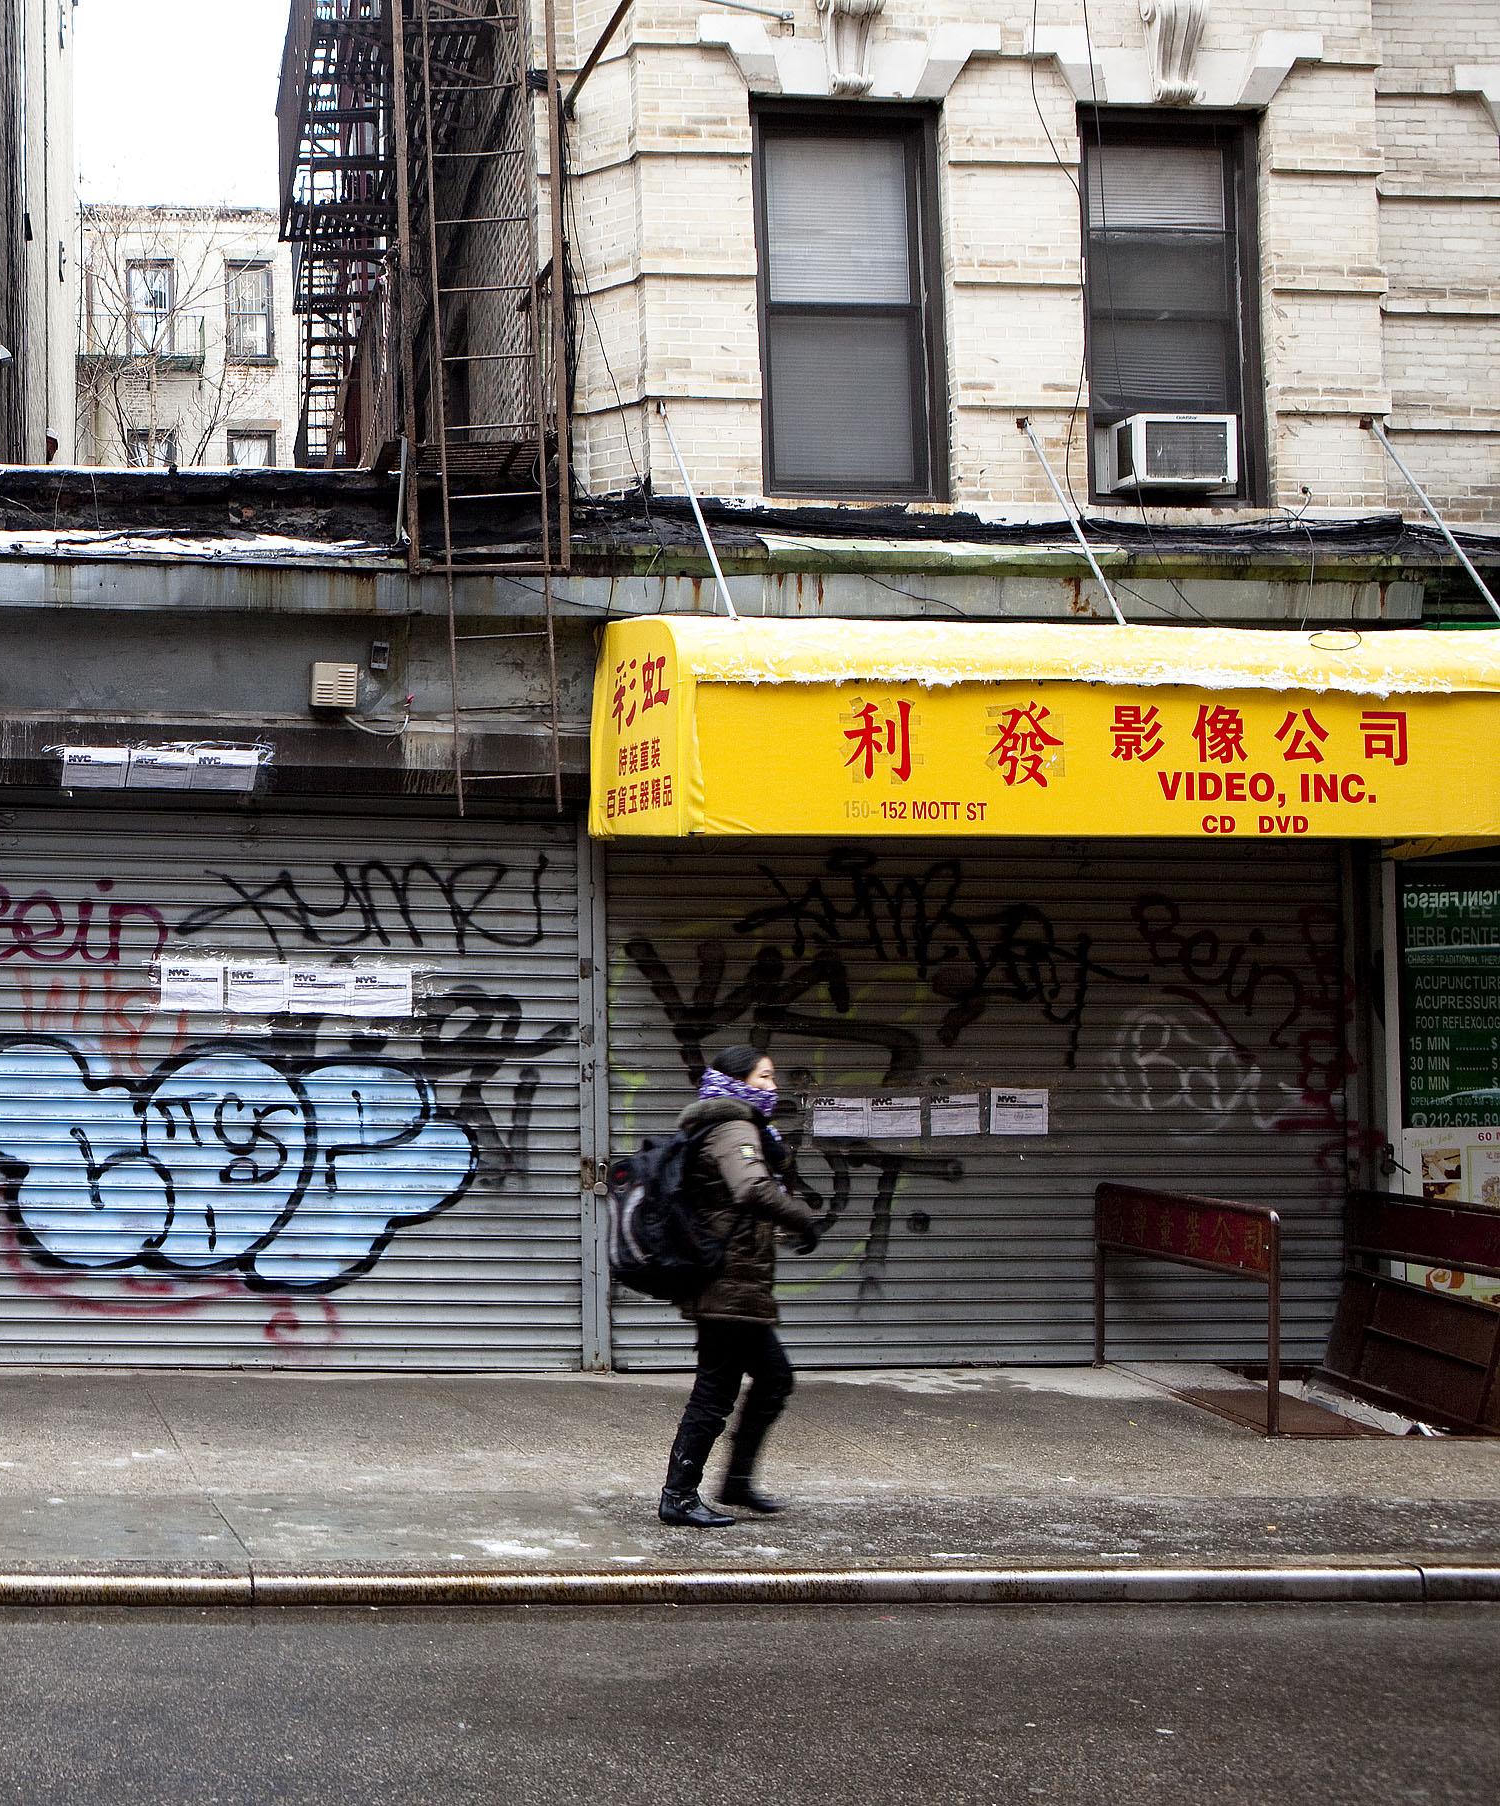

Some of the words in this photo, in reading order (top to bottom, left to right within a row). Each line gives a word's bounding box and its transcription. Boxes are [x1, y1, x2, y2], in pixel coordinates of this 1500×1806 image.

[611, 651, 671, 735] 彩虹
[843, 699, 1409, 788] 利發影像公司
[68, 755, 92, 763] NYC
[199, 757, 221, 765] NYC
[606, 775, 673, 819] 百貨玉器精品
[1157, 771, 1287, 809] VIDEO,
[1300, 773, 1377, 804] INC.
[912, 800, 961, 820] MOTT
[966, 802, 988, 821] ST
[1201, 815, 1236, 834] CD
[1258, 815, 1310, 834] DVD
[1406, 926, 1447, 946] HERB
[168, 969, 190, 977] NYC
[295, 974, 317, 982] NYC
[356, 976, 378, 984] NYC
[1415, 1015, 1440, 1029] FOOT
[1410, 1036, 1423, 1051] 15
[1427, 1036, 1450, 1051] MIN
[1410, 1056, 1423, 1071] 30
[1427, 1056, 1450, 1071] MIN
[1410, 1076, 1423, 1091] 60
[1427, 1076, 1450, 1091] MIN
[872, 1098, 893, 1106] NYC
[930, 1096, 950, 1104] NYC
[1478, 1132, 1493, 1141] 60
